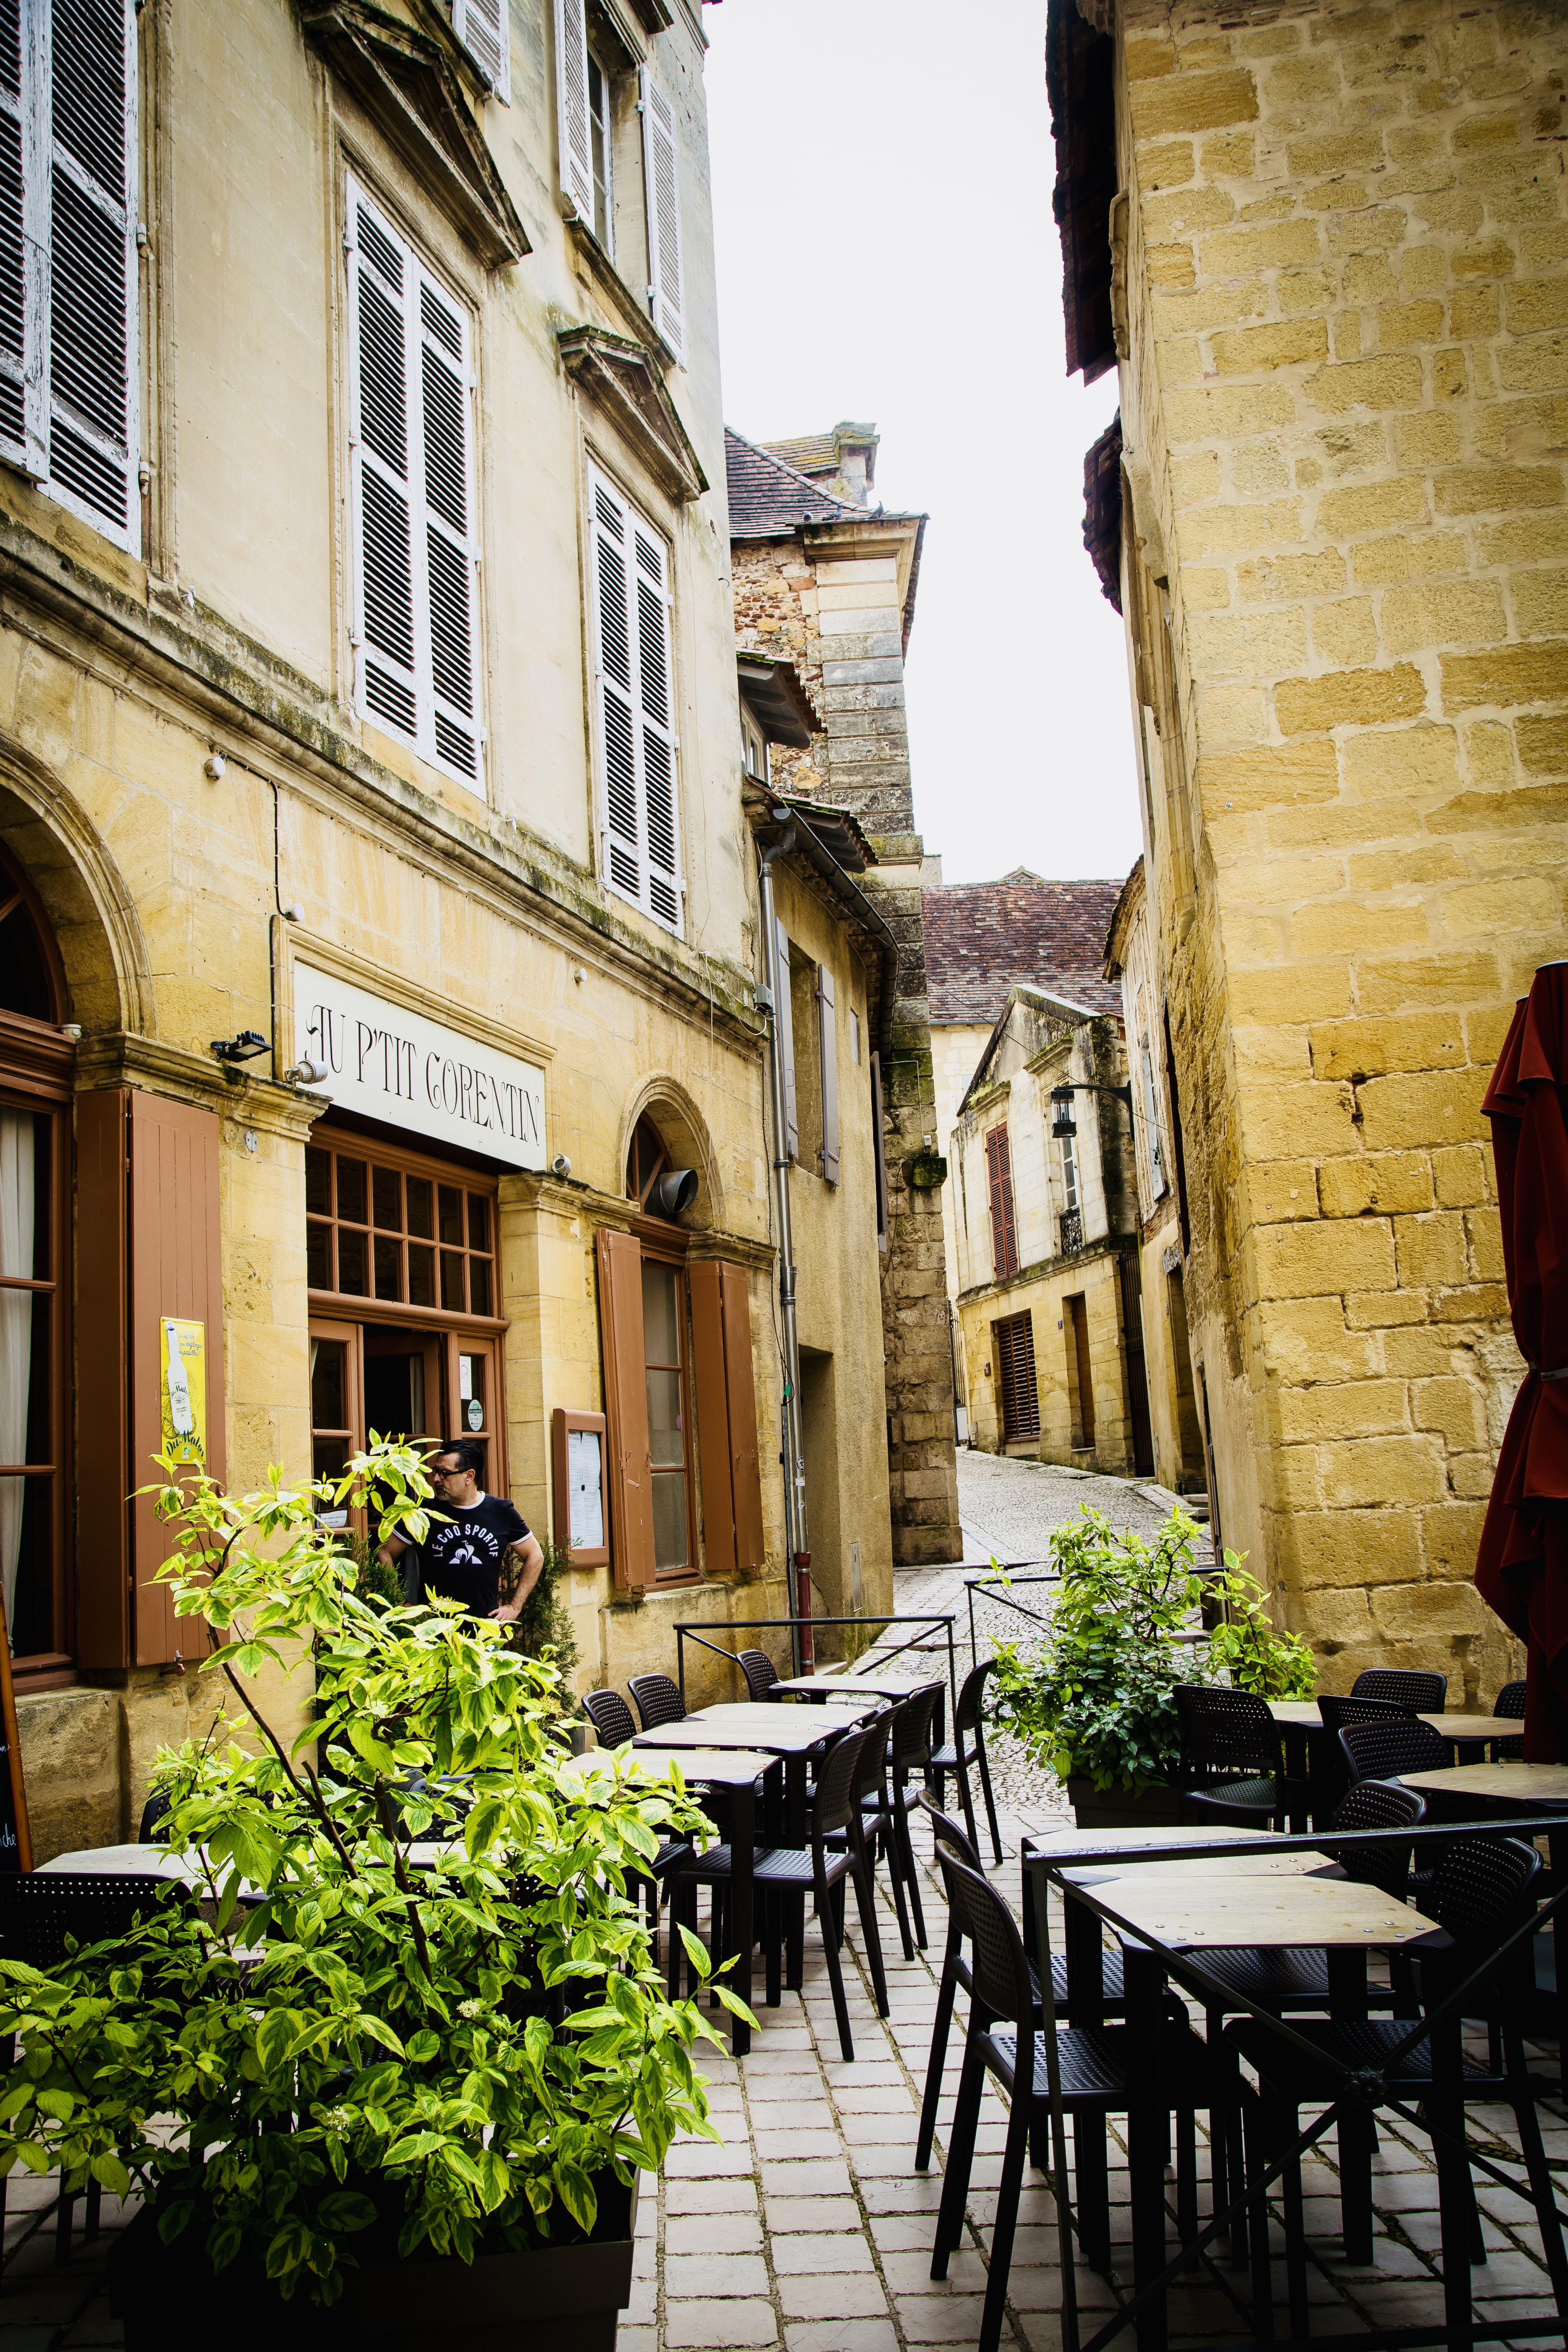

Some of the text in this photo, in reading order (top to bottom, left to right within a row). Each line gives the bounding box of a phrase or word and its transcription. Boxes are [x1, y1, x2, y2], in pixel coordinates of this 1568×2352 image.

[305, 1004, 539, 1146] AU P'TIT CORENTIN
[432, 1524, 499, 1557] LE COQ SPORTIF
[0, 1823, 16, 1847] che
